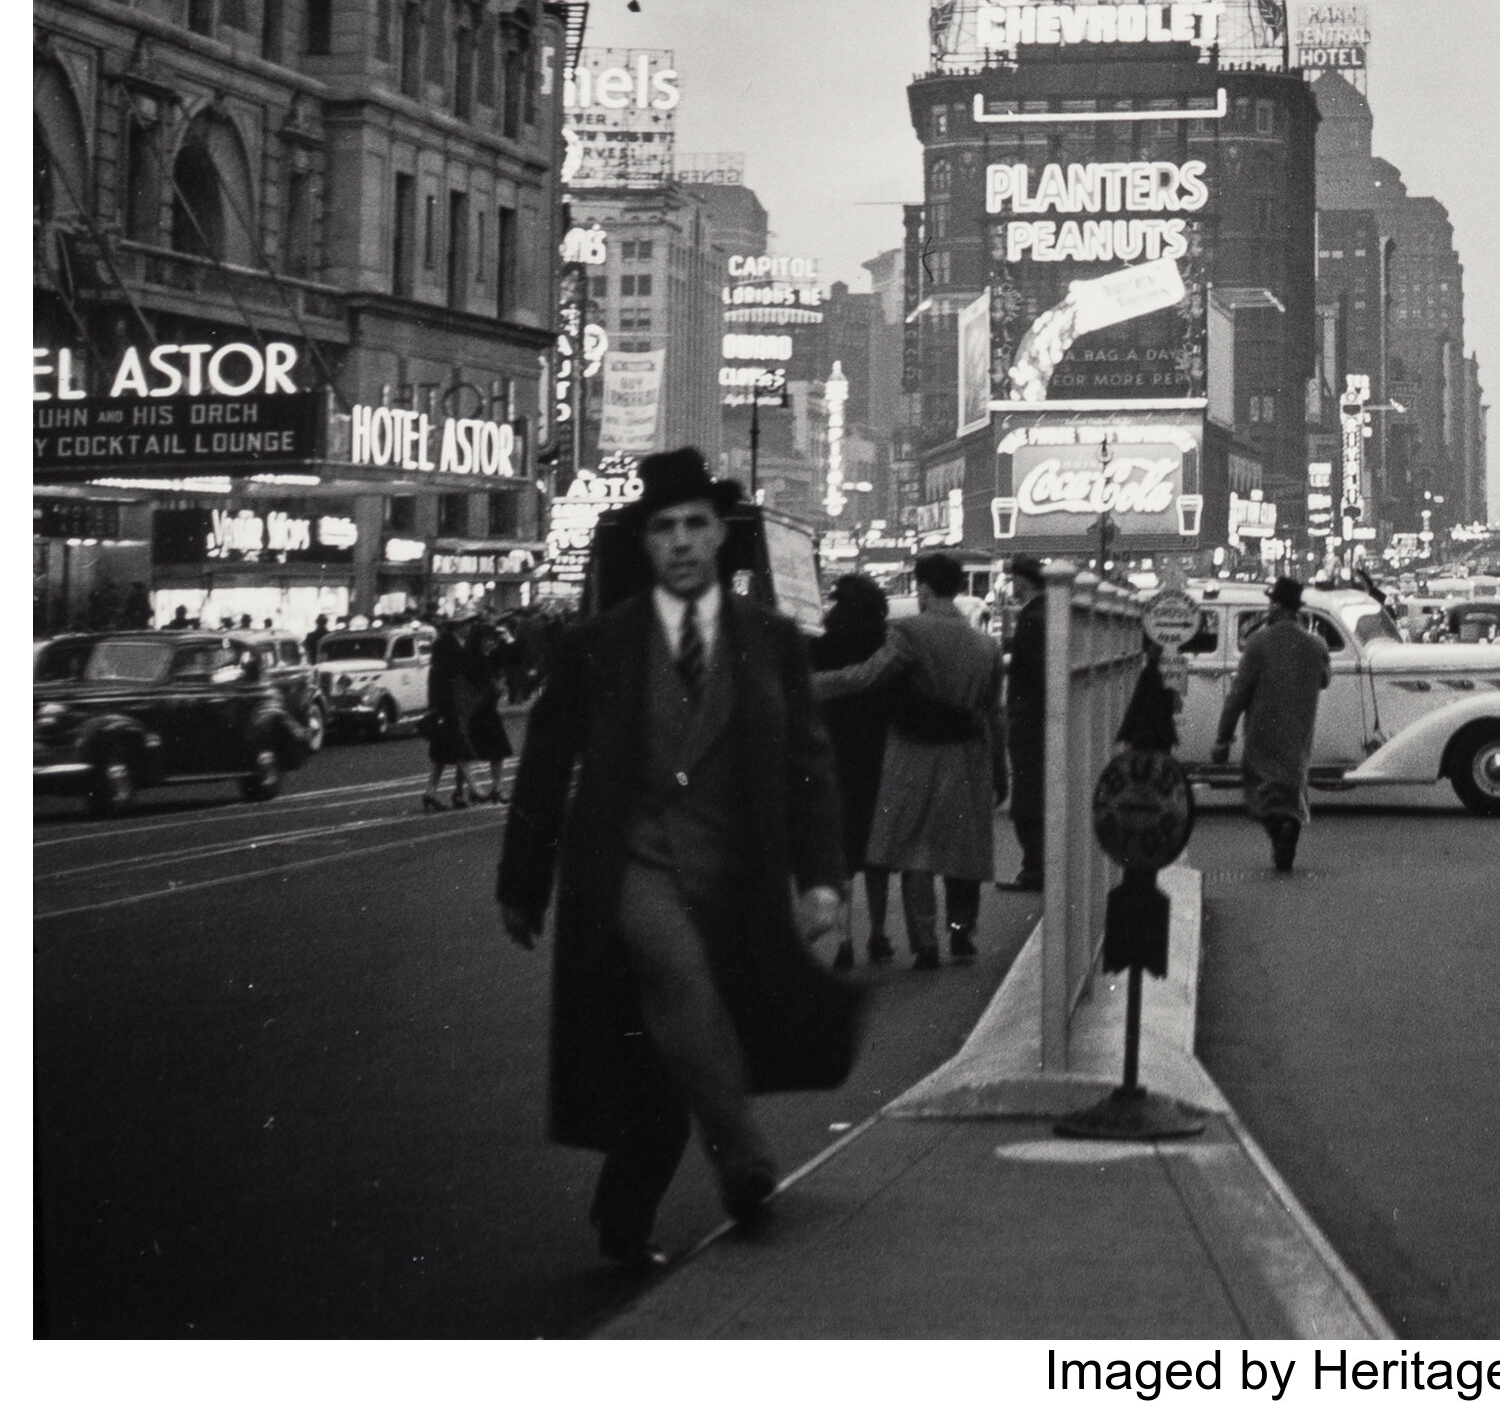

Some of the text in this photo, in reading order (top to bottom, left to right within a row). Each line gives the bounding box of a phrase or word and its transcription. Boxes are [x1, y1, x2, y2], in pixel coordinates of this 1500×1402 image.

[976, 3, 1227, 46] CHEVROLET
[1300, 48, 1363, 66] HOTEL
[986, 160, 1208, 215] PLANTERS
[1006, 218, 1188, 263] PEANUTS
[728, 254, 818, 278] CAPITOL
[1084, 349, 1120, 362] BAG
[109, 341, 299, 398] ASTOR
[1052, 373, 1086, 386] FOR
[1093, 373, 1145, 386] MORE
[33, 402, 258, 429] UHN AND HIS ORCH
[57, 434, 187, 457] COCKTAIL
[195, 430, 296, 454] LOUNGE
[352, 404, 514, 478] HOTEL ASTOR
[565, 477, 645, 498] ASTO
